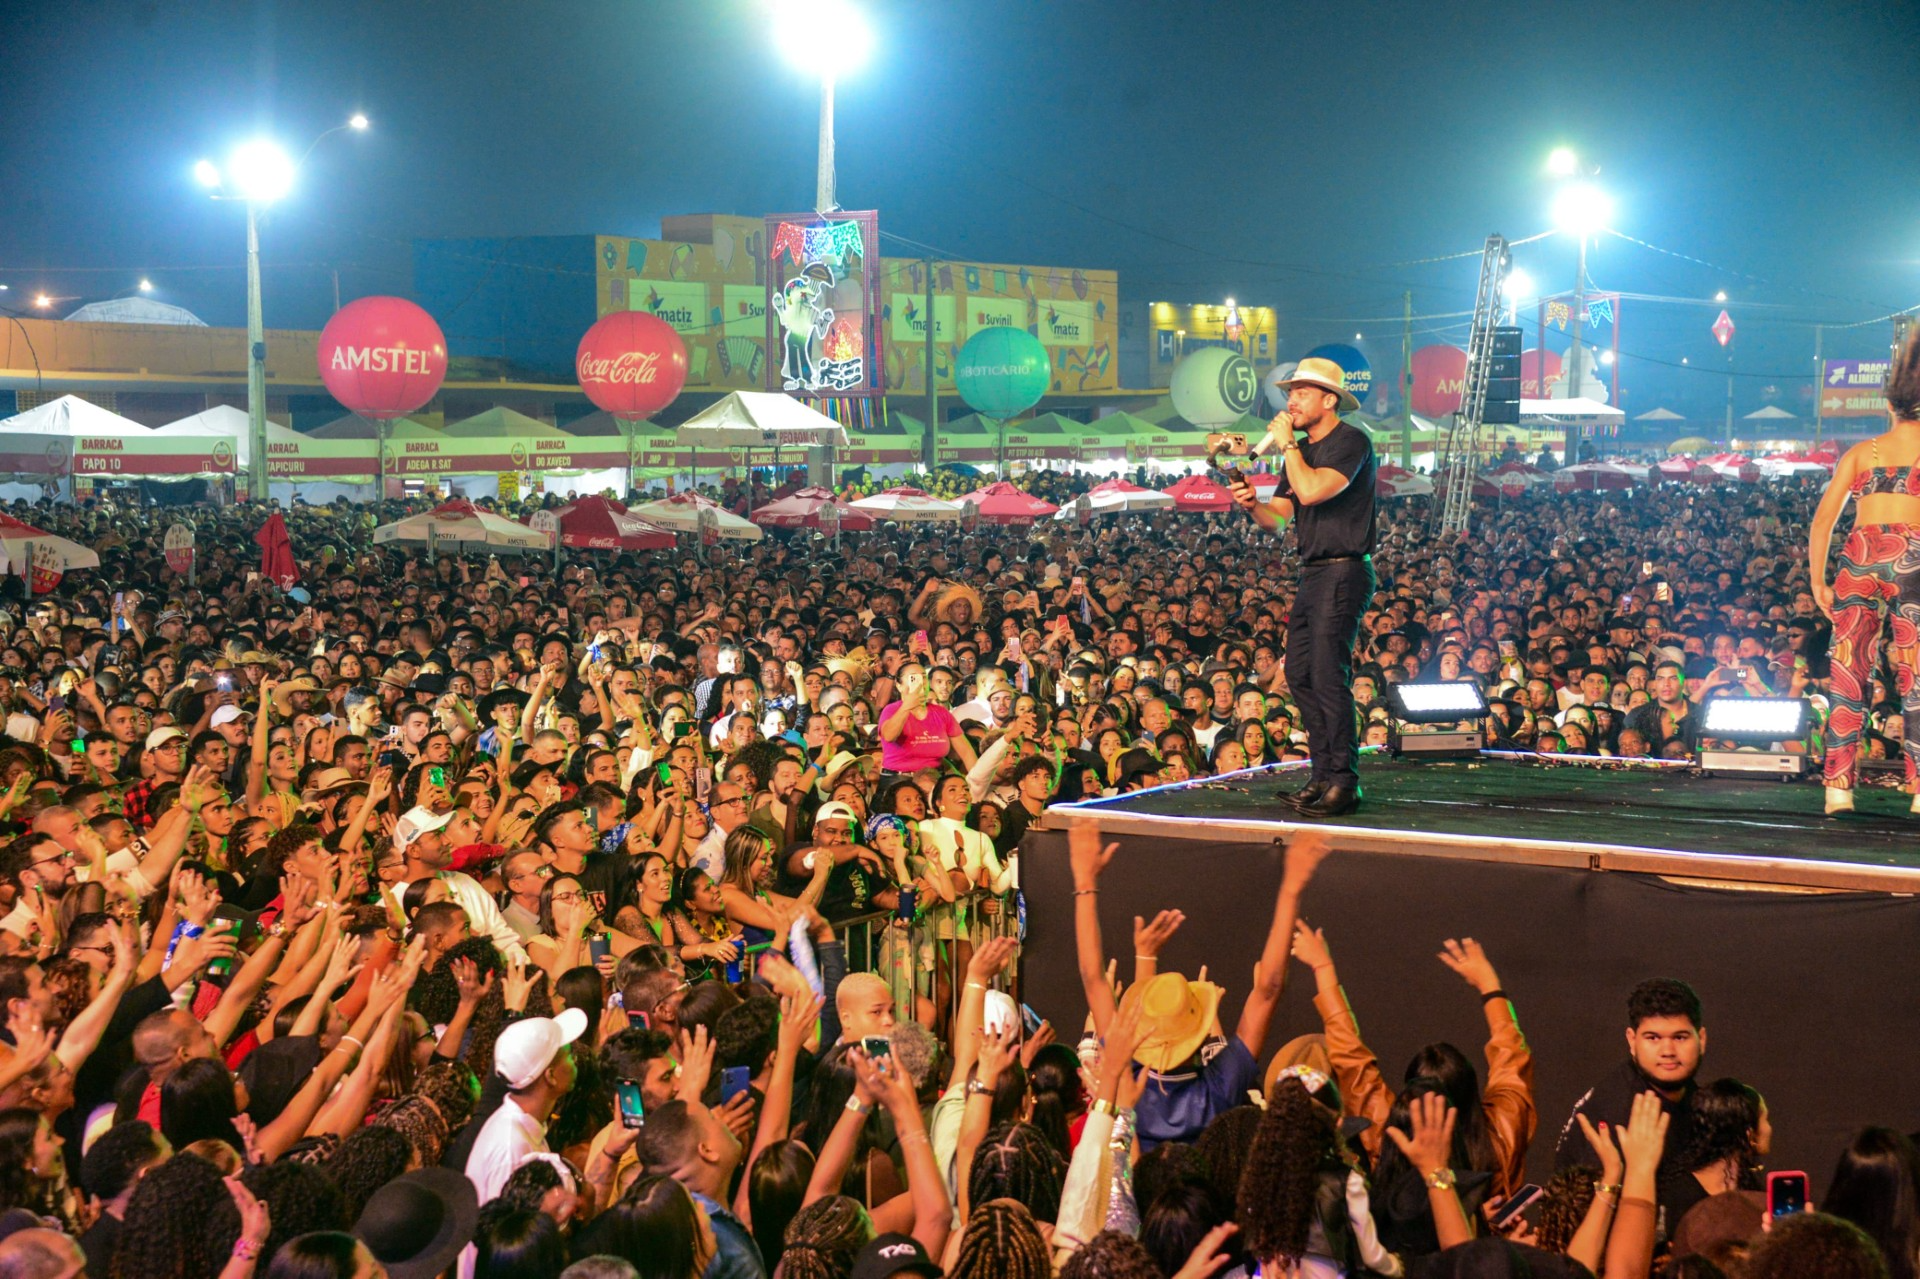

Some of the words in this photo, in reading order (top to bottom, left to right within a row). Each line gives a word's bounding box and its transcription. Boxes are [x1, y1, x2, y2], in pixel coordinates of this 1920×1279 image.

[656, 306, 693, 323] matiz
[986, 313, 1012, 326] Suvinil
[912, 320, 941, 331] maz
[1054, 322, 1080, 335] matiz
[331, 345, 431, 375] AMSTEL
[579, 351, 661, 384] Coca-Cola
[1344, 370, 1372, 380] ortes
[1235, 366, 1251, 402] 5
[81, 439, 124, 450] BARRACA
[267, 443, 299, 454] ARRACA
[405, 442, 439, 453] BARRACA
[536, 440, 566, 450] BARRACA
[650, 439, 675, 448] BARRACA
[82, 458, 107, 470] PAPO
[110, 458, 121, 470] 10
[406, 459, 430, 470] ADEGA
[439, 459, 452, 469] SAT
[536, 457, 545, 467] DO
[547, 456, 572, 467] XAVECO
[1184, 491, 1215, 500] Coca-Cola
[655, 520, 678, 529] AMSTEL
[722, 527, 742, 536] AMSTEL
[507, 538, 528, 546] AMSTEL
[588, 536, 616, 548] Coca-Cola
